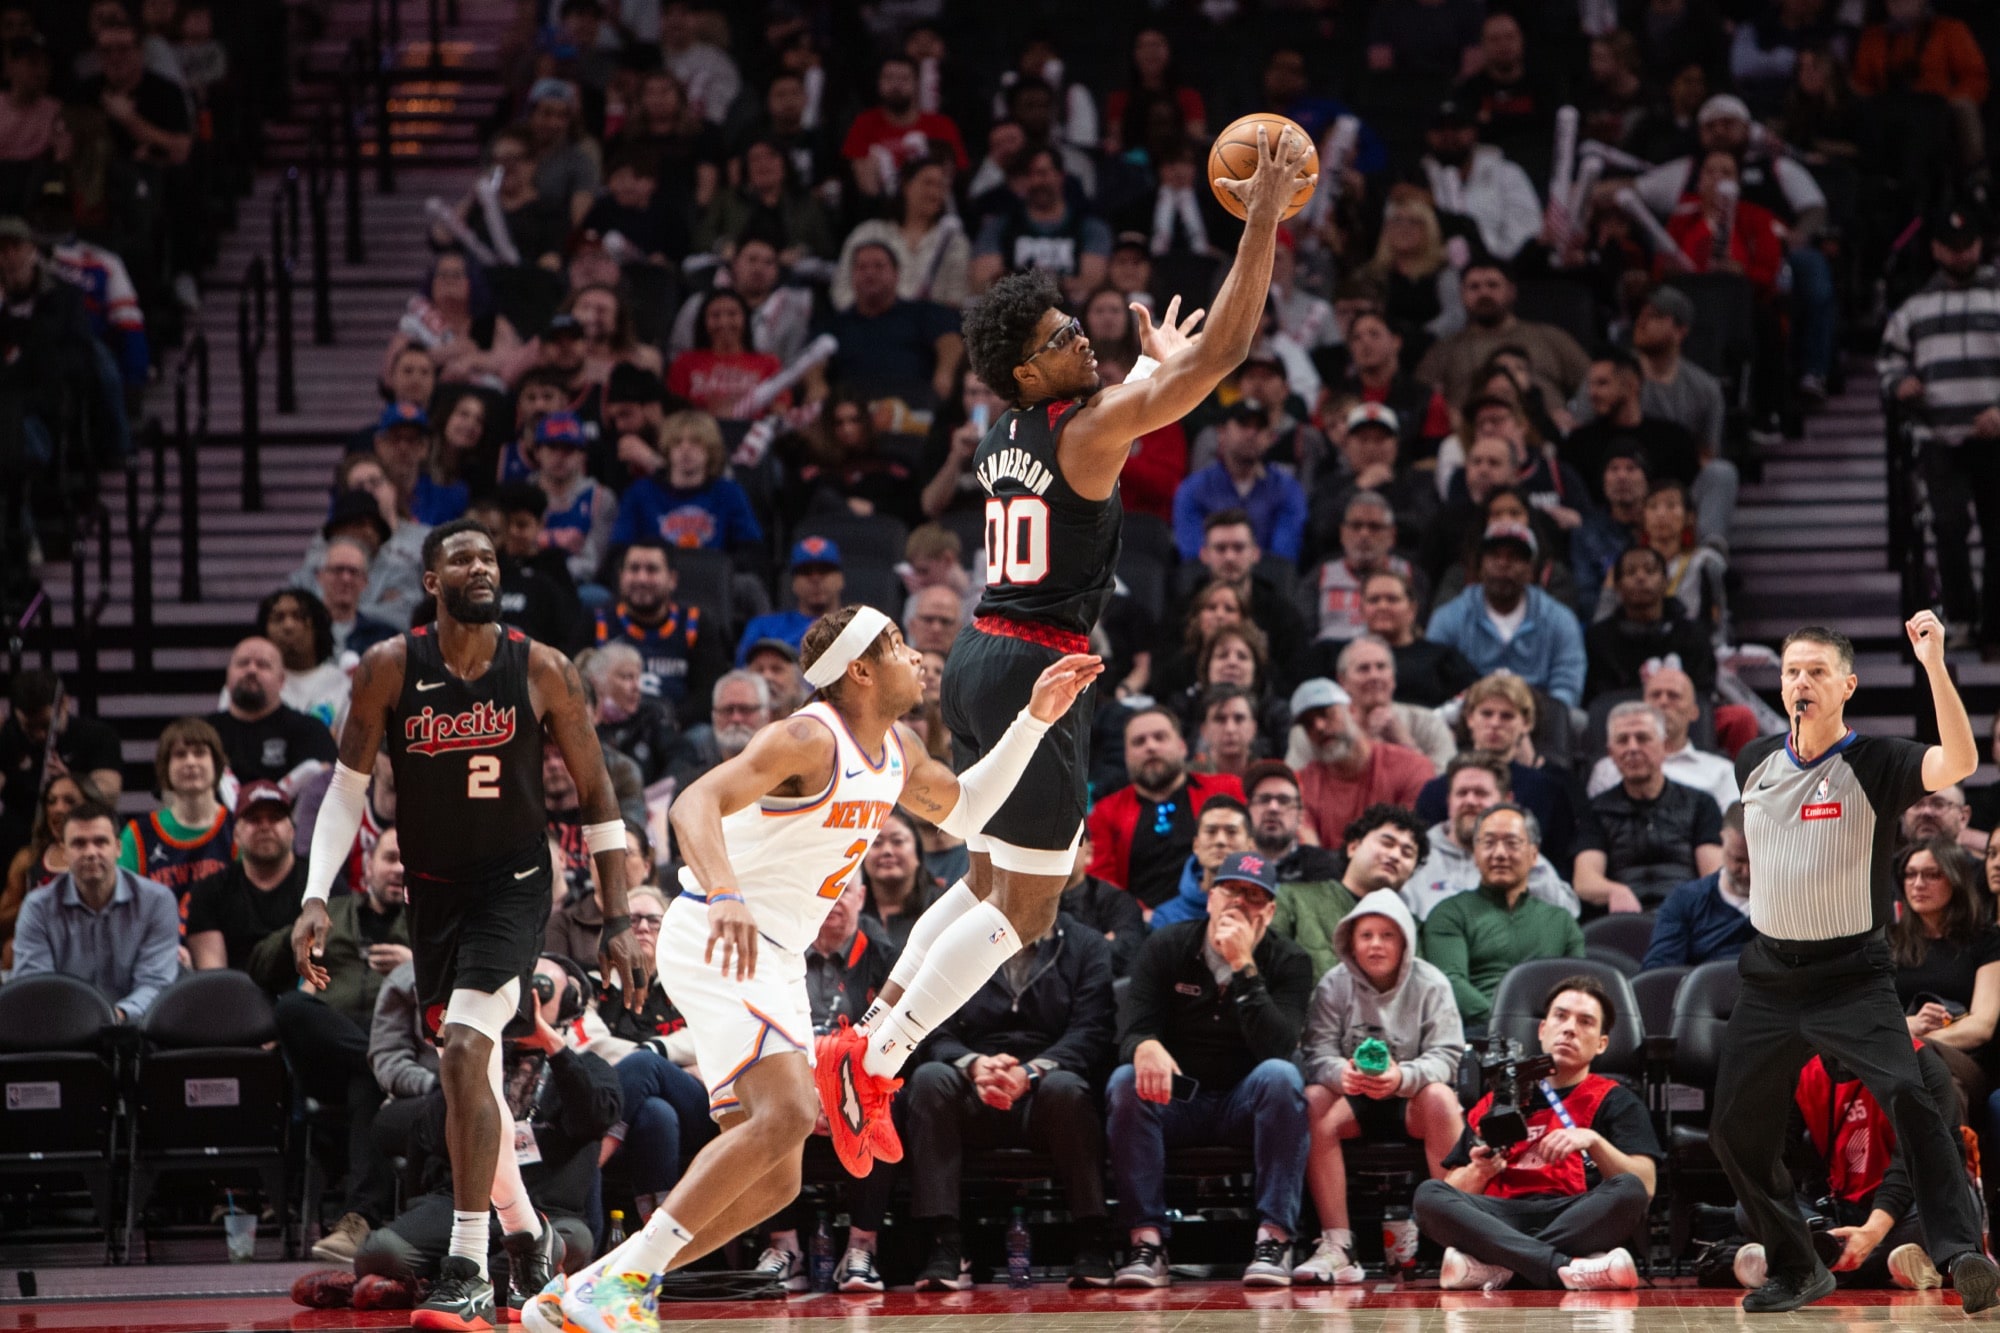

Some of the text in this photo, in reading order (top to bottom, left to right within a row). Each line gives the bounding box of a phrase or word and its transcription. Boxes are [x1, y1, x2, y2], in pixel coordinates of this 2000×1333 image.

[985, 497, 1050, 585] 00
[405, 699, 516, 757] ripcity
[467, 755, 501, 799] 2
[822, 800, 869, 829] NEW
[1805, 807, 1838, 817] Emirates
[817, 838, 868, 900] 2
